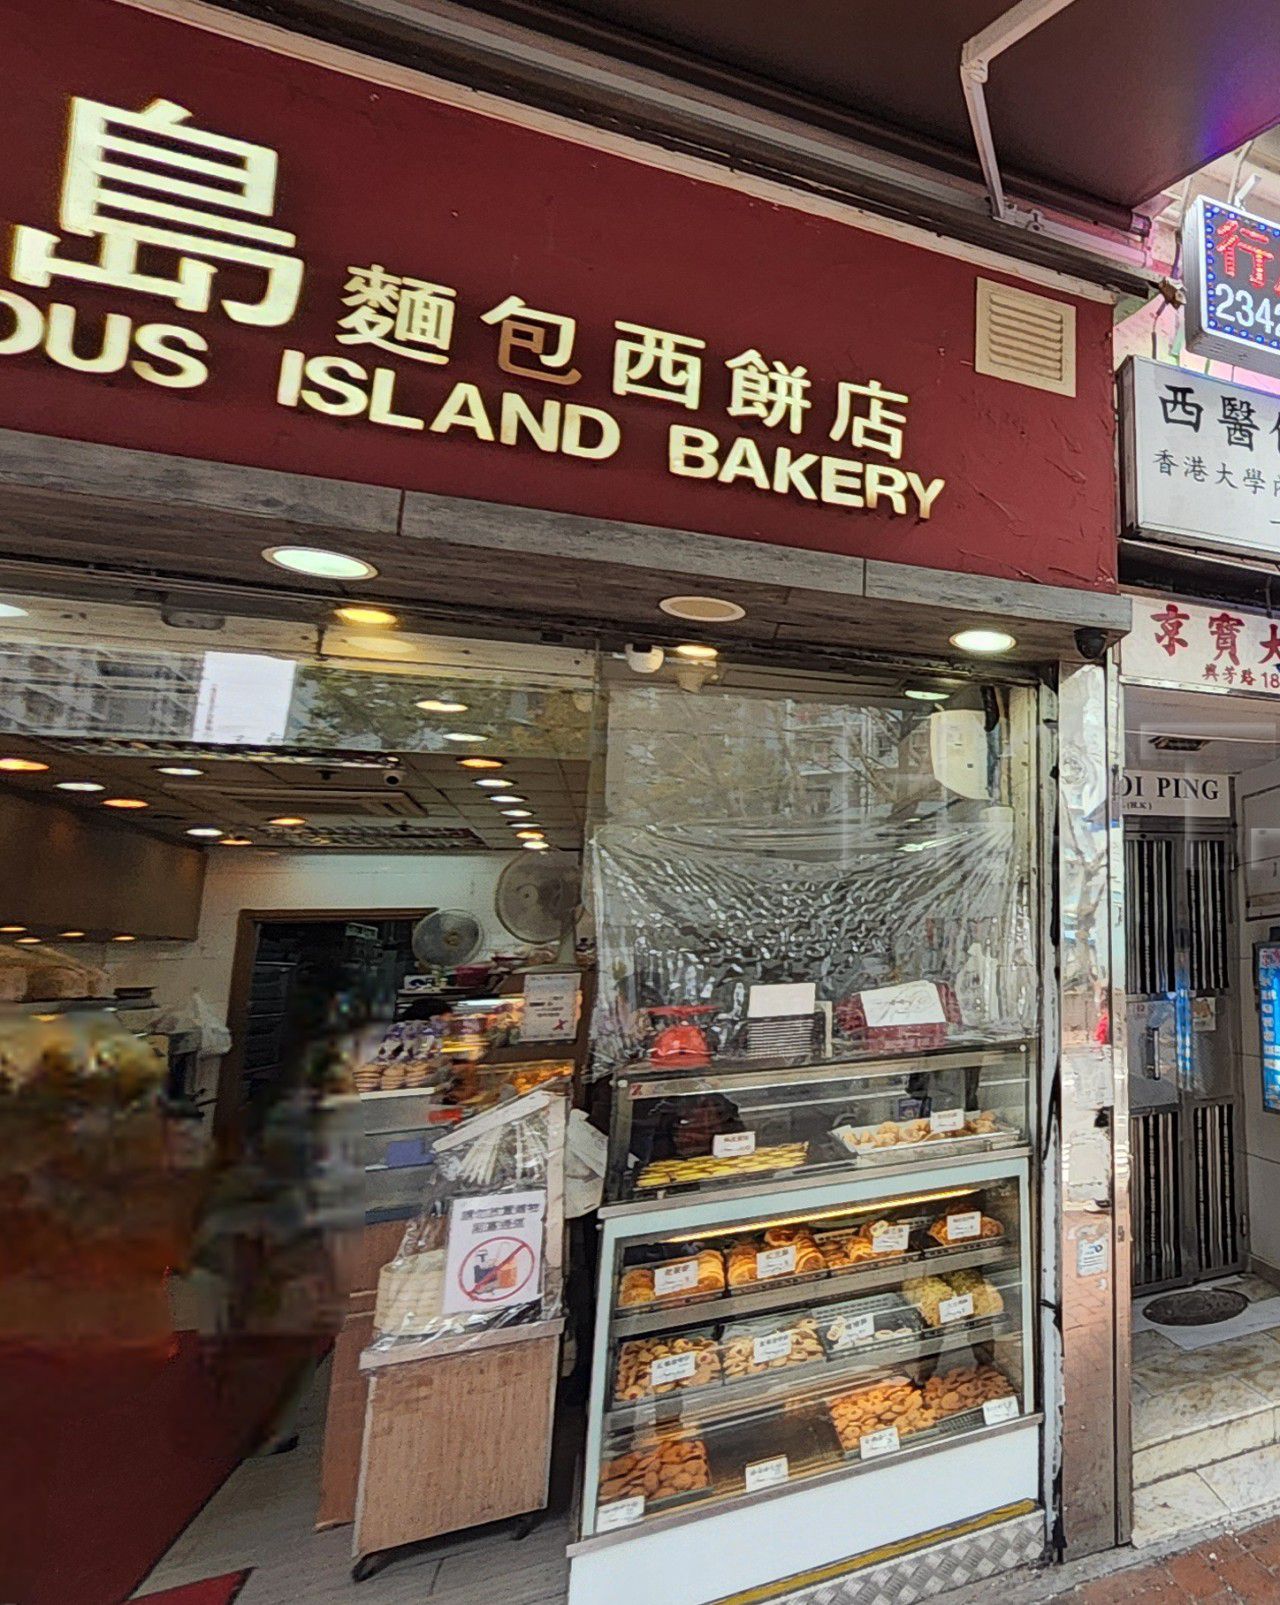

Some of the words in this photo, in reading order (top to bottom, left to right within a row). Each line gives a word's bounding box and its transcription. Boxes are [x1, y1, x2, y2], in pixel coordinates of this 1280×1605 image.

[11, 96, 305, 328] 島
[277, 348, 621, 461] ISLAND
[668, 424, 946, 520] BAKERY
[335, 264, 910, 460] 麵包西餅店
[1156, 776, 1219, 800] PING
